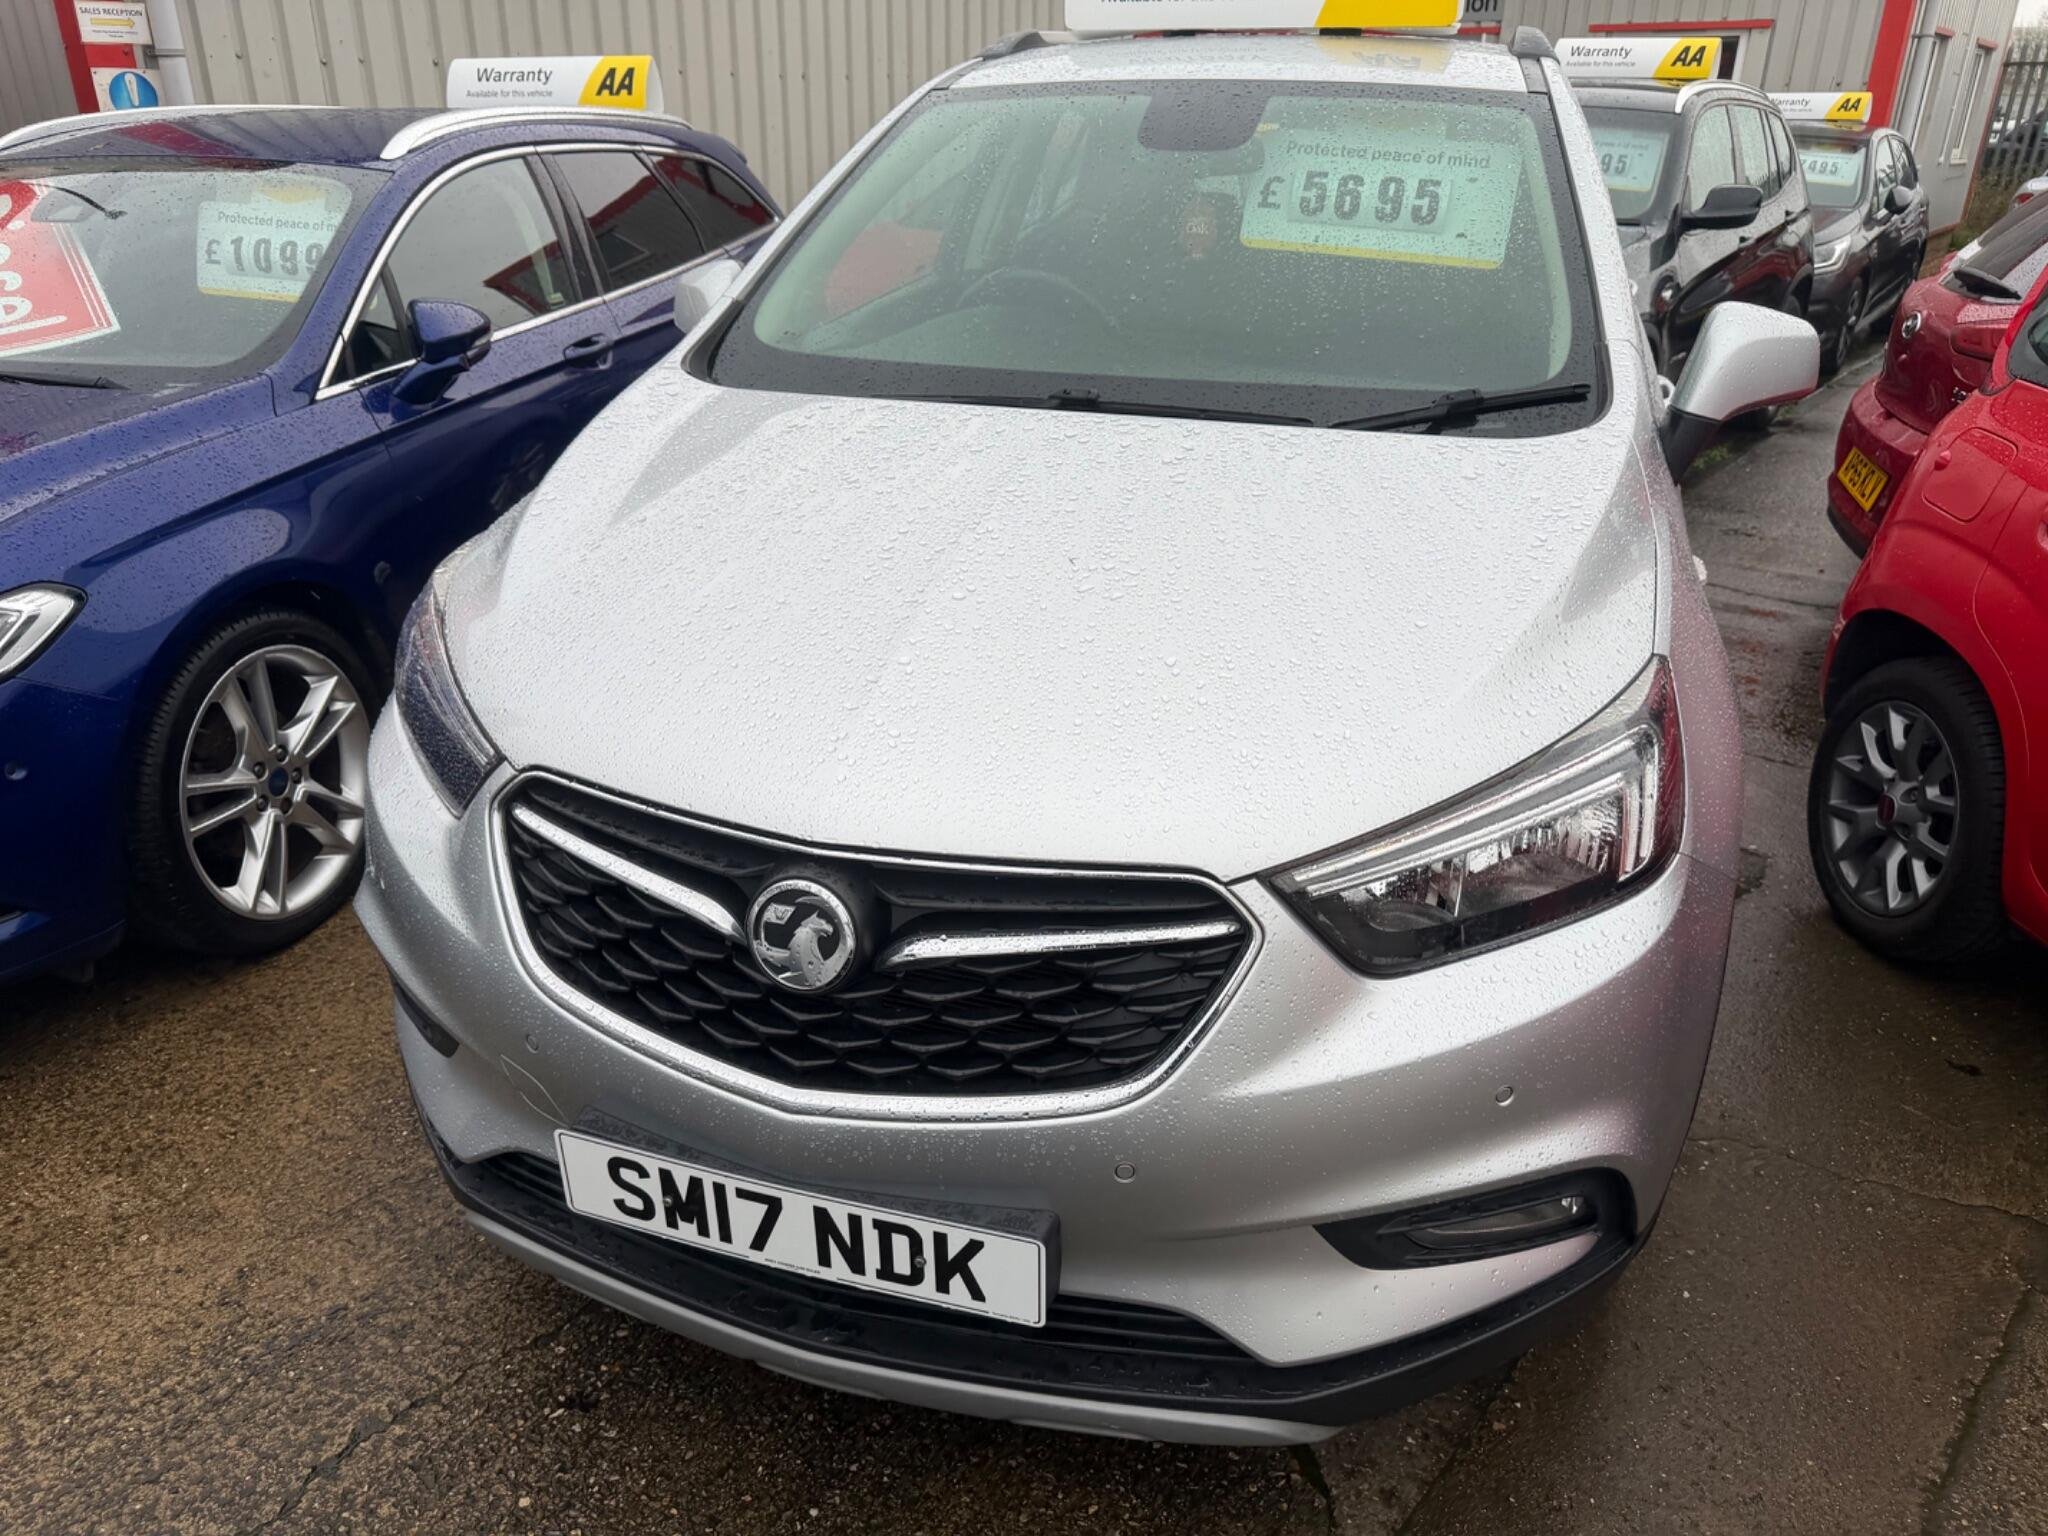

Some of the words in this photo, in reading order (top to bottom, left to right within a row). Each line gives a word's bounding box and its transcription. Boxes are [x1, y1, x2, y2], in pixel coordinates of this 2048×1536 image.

[79, 7, 101, 15] SALES
[102, 8, 143, 17] RECEPTION
[1570, 45, 1632, 59] Warranty
[1670, 45, 1707, 67] AA
[476, 67, 552, 86] Warranty
[596, 67, 636, 97] AA
[466, 89, 498, 98] Available
[499, 89, 510, 98] for
[512, 89, 525, 98] this
[527, 89, 553, 98] vehicle
[1837, 97, 1862, 112] AA
[1287, 140, 1368, 160] Protected
[1371, 144, 1423, 164] peace
[1426, 150, 1446, 165] of
[1447, 153, 1492, 169] mind
[218, 211, 273, 226] Protected
[275, 216, 310, 230] peace
[312, 219, 325, 231] of
[607, 1156, 783, 1252] SM17
[812, 1204, 987, 1304] NDK
